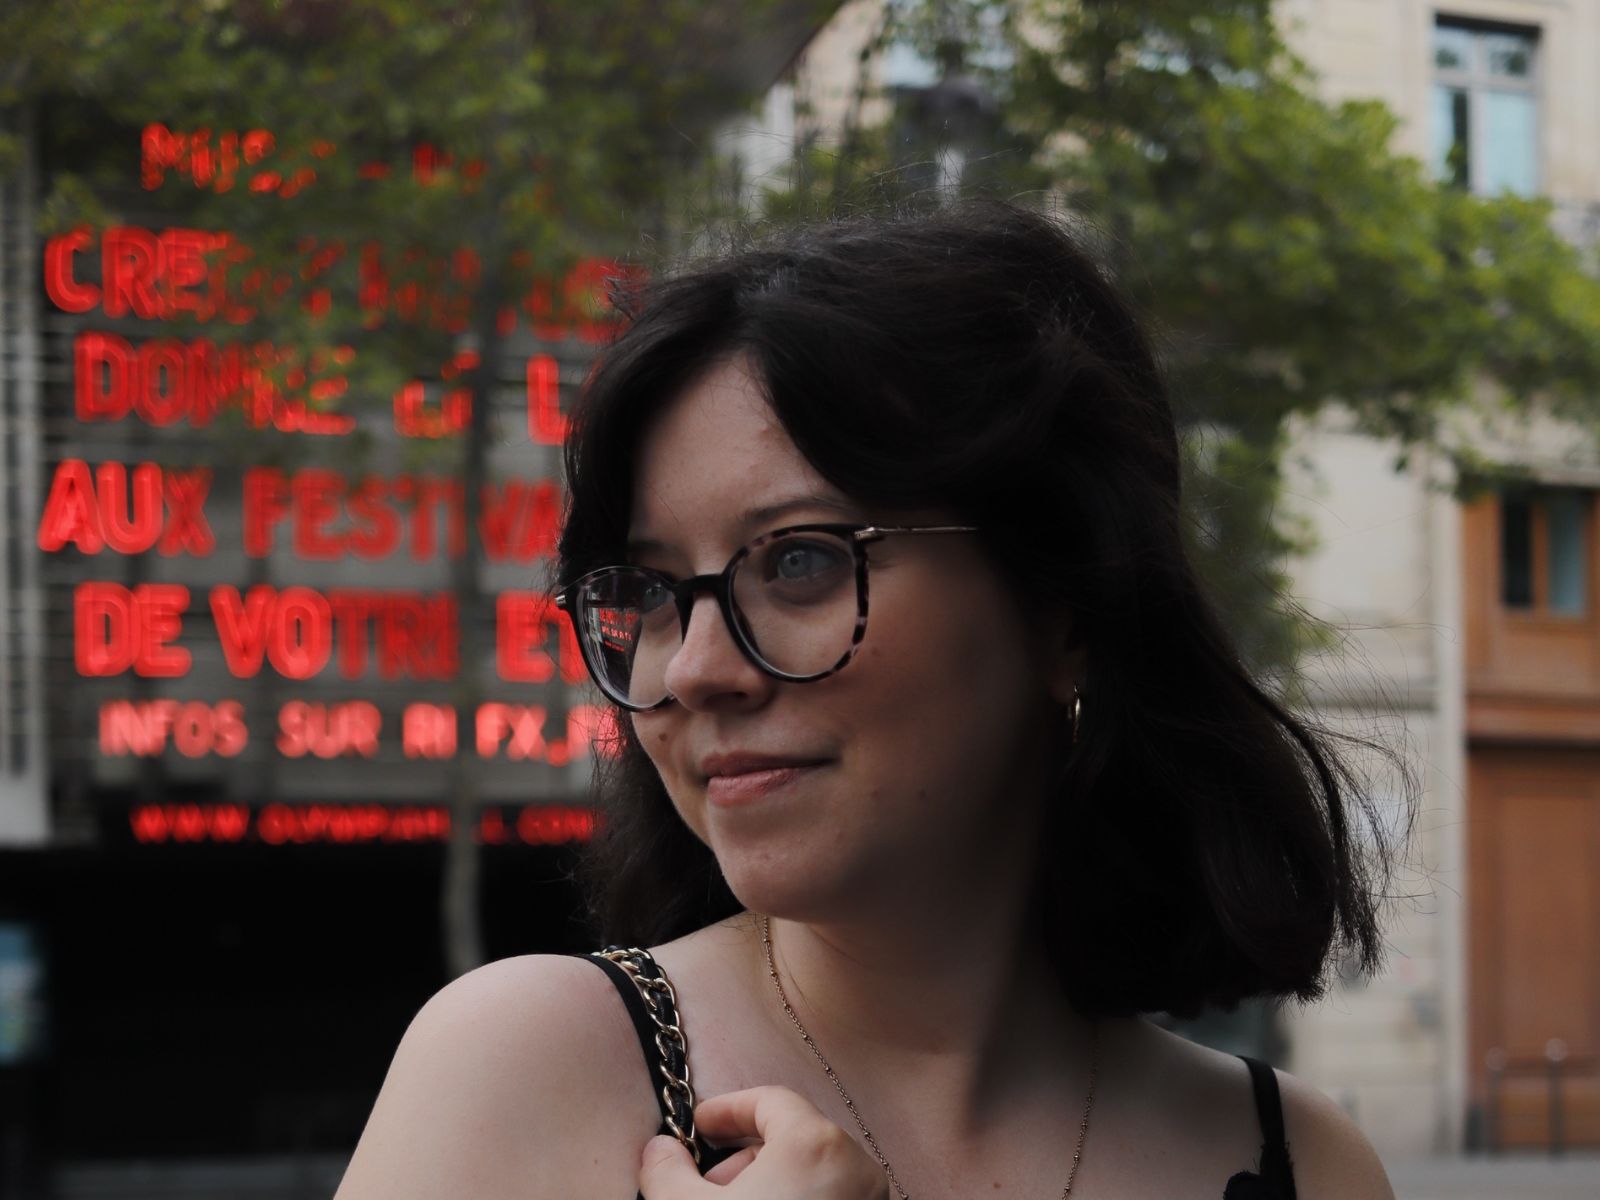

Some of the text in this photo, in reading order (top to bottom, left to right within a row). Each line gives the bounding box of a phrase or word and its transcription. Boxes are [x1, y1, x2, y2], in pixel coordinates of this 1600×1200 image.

[38, 458, 566, 564] AUX FESTIVA
[74, 581, 192, 678] DE
[276, 699, 382, 759] SUR
